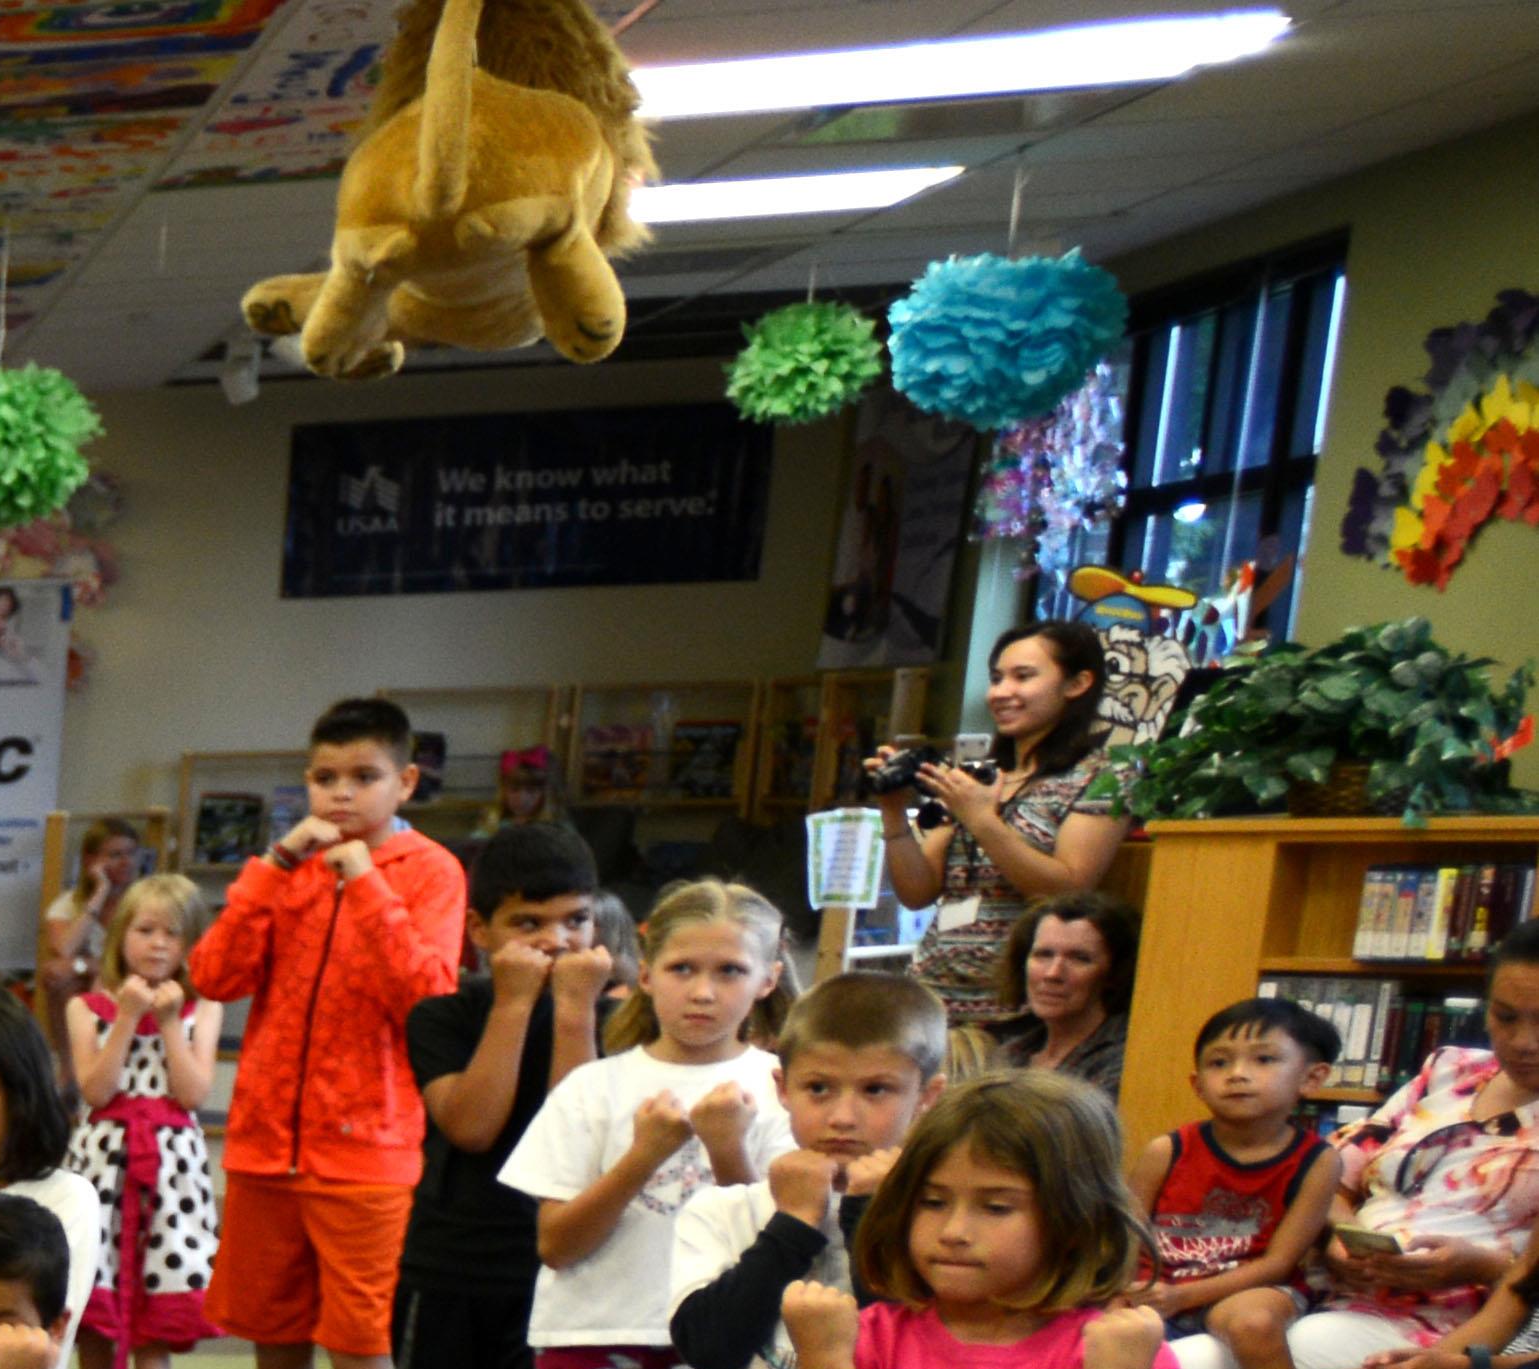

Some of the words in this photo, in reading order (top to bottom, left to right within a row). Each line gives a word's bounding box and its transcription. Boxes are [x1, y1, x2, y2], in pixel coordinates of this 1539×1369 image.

[436, 466, 487, 494] We
[494, 464, 583, 492] know
[590, 458, 673, 486] what
[433, 501, 456, 527] it
[464, 500, 570, 527] means
[578, 498, 611, 521] to
